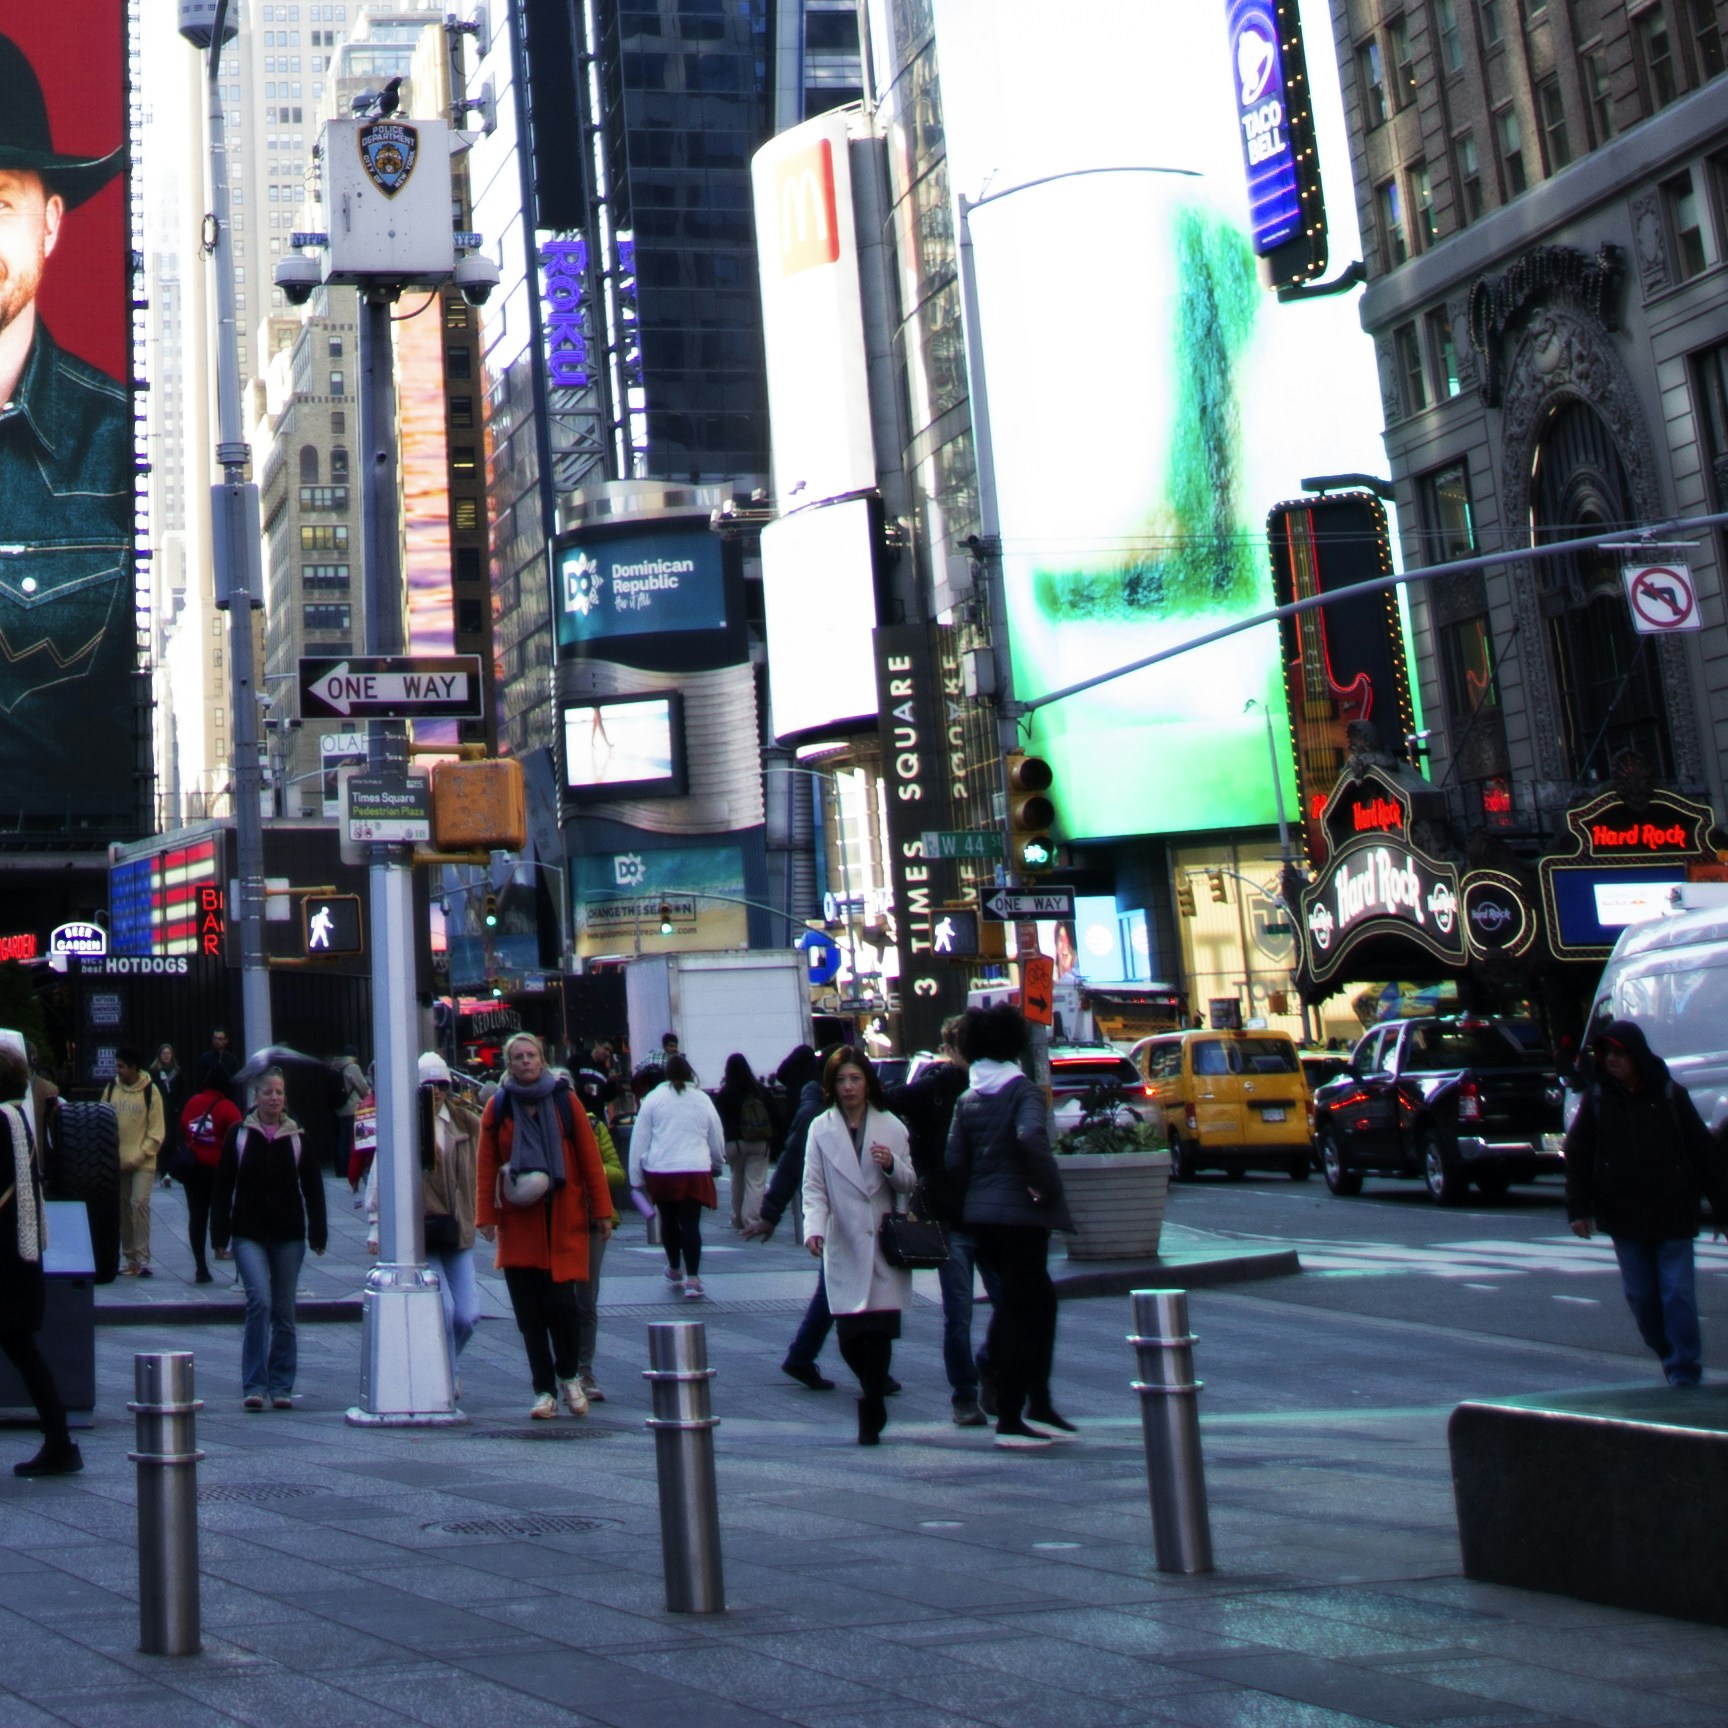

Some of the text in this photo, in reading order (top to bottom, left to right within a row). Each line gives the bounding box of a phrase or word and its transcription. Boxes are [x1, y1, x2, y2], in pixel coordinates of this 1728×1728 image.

[1241, 100, 1282, 140] TACO
[361, 134, 415, 147] DEPARTMENT
[1248, 128, 1286, 166] BELL
[363, 154, 375, 173] CITY
[394, 173, 407, 188] NEW
[404, 151, 415, 174] YORK
[611, 558, 693, 579] Dominican
[612, 575, 679, 595] Republic
[327, 675, 457, 700] ONE WAY
[352, 792, 416, 805] Times Square
[352, 806, 401, 817] Pedestrian
[401, 806, 425, 817] Plaza
[1353, 798, 1378, 831] Hard
[1378, 797, 1402, 832] Rock
[888, 655, 939, 996] 3 TIMES SQUARE
[941, 835, 956, 855] W
[964, 834, 985, 855] 44
[1593, 823, 1687, 850] Hard Rock
[1334, 846, 1425, 929] Hard Rock
[589, 906, 623, 920] CHANGE
[995, 895, 1063, 911] ONE WAY
[64, 927, 93, 939] BEER
[56, 940, 101, 951] GARDEN
[81, 957, 188, 974] best HOTDOGS
[822, 992, 902, 1012] CSE
[472, 1011, 490, 1037] RED
